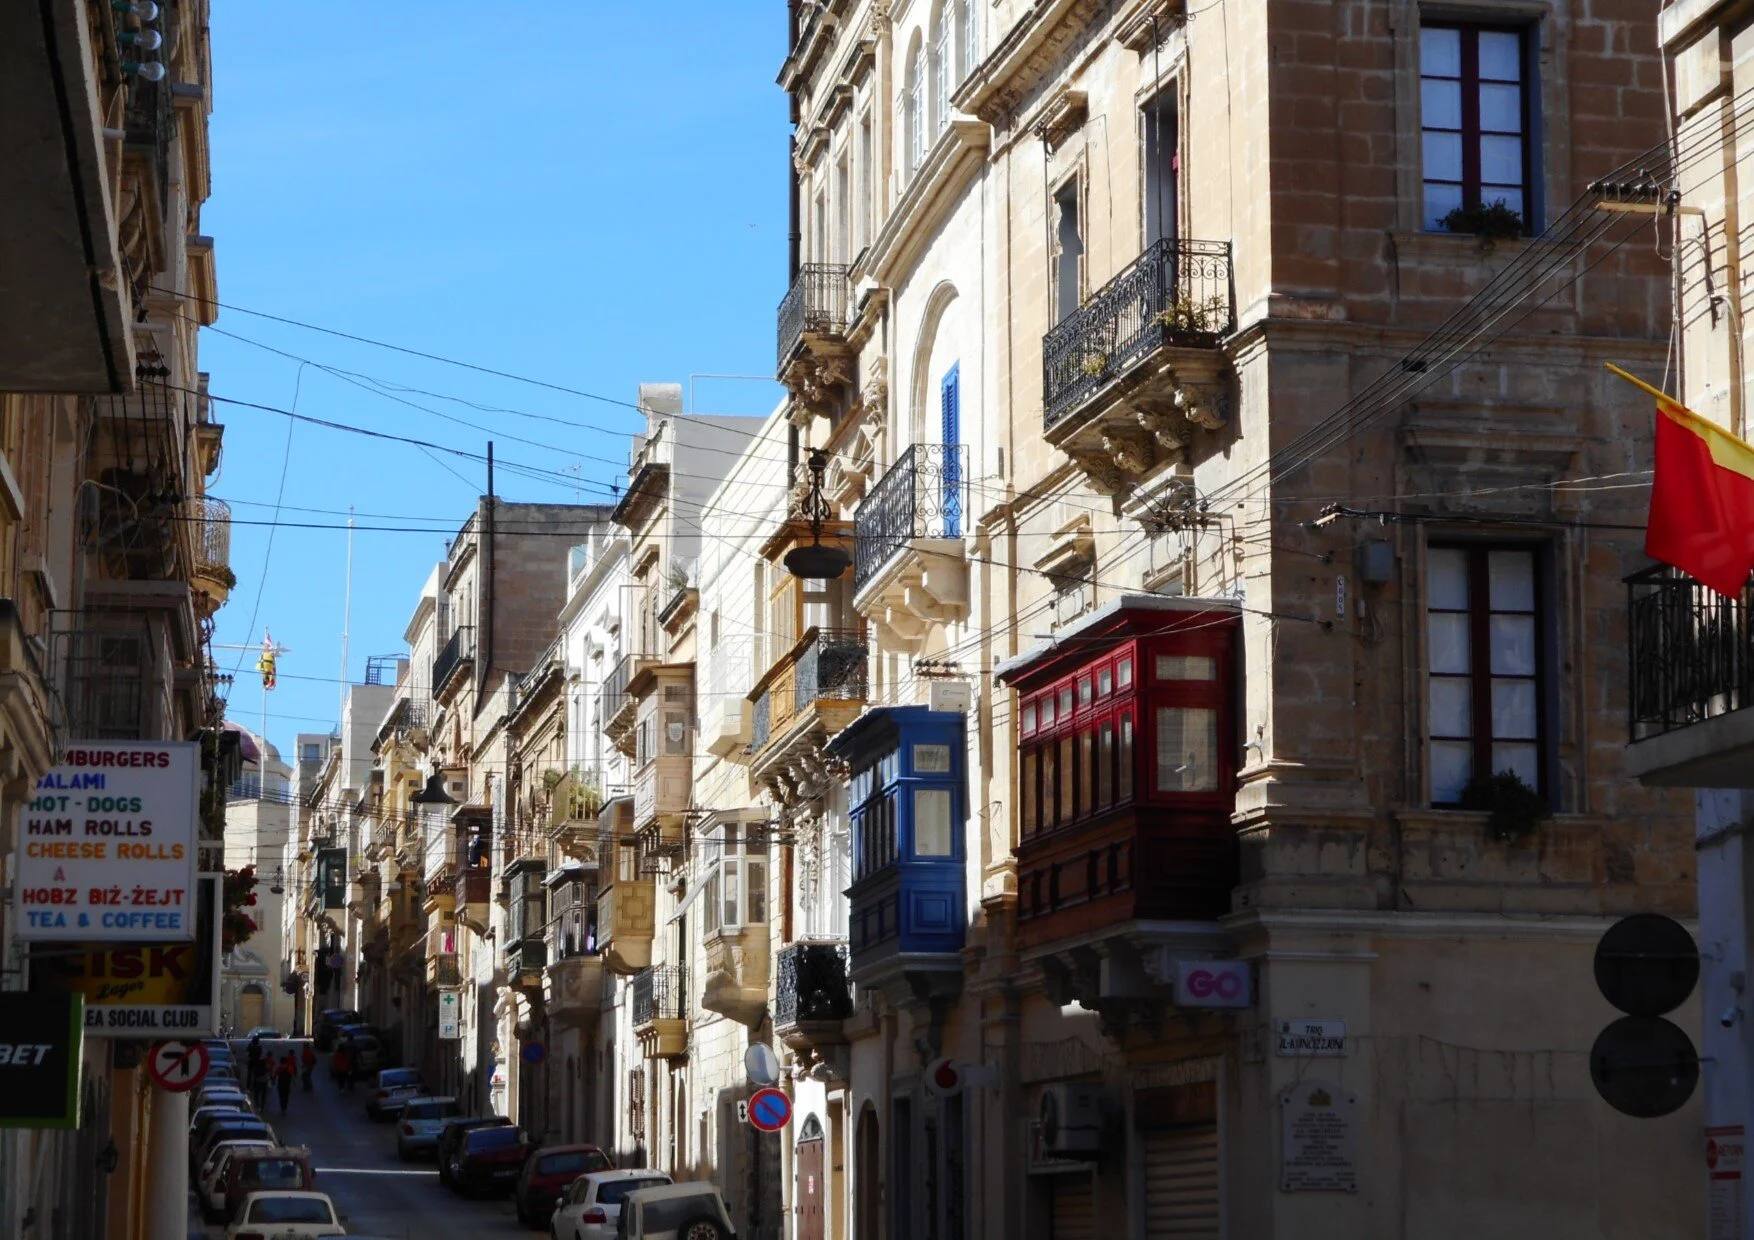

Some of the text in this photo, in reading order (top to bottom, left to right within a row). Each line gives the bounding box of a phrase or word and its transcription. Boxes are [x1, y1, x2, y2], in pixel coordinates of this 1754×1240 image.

[28, 796, 70, 812] HOT
[88, 797, 142, 812] DOGS
[28, 818, 152, 836] HAM ROLLS
[27, 842, 185, 860] CHEESE ROLLS
[27, 911, 67, 928] TEA
[102, 912, 181, 929] COFFEE
[1187, 970, 1243, 1000] GO
[84, 1009, 199, 1028] EA SOCIAL CLUB
